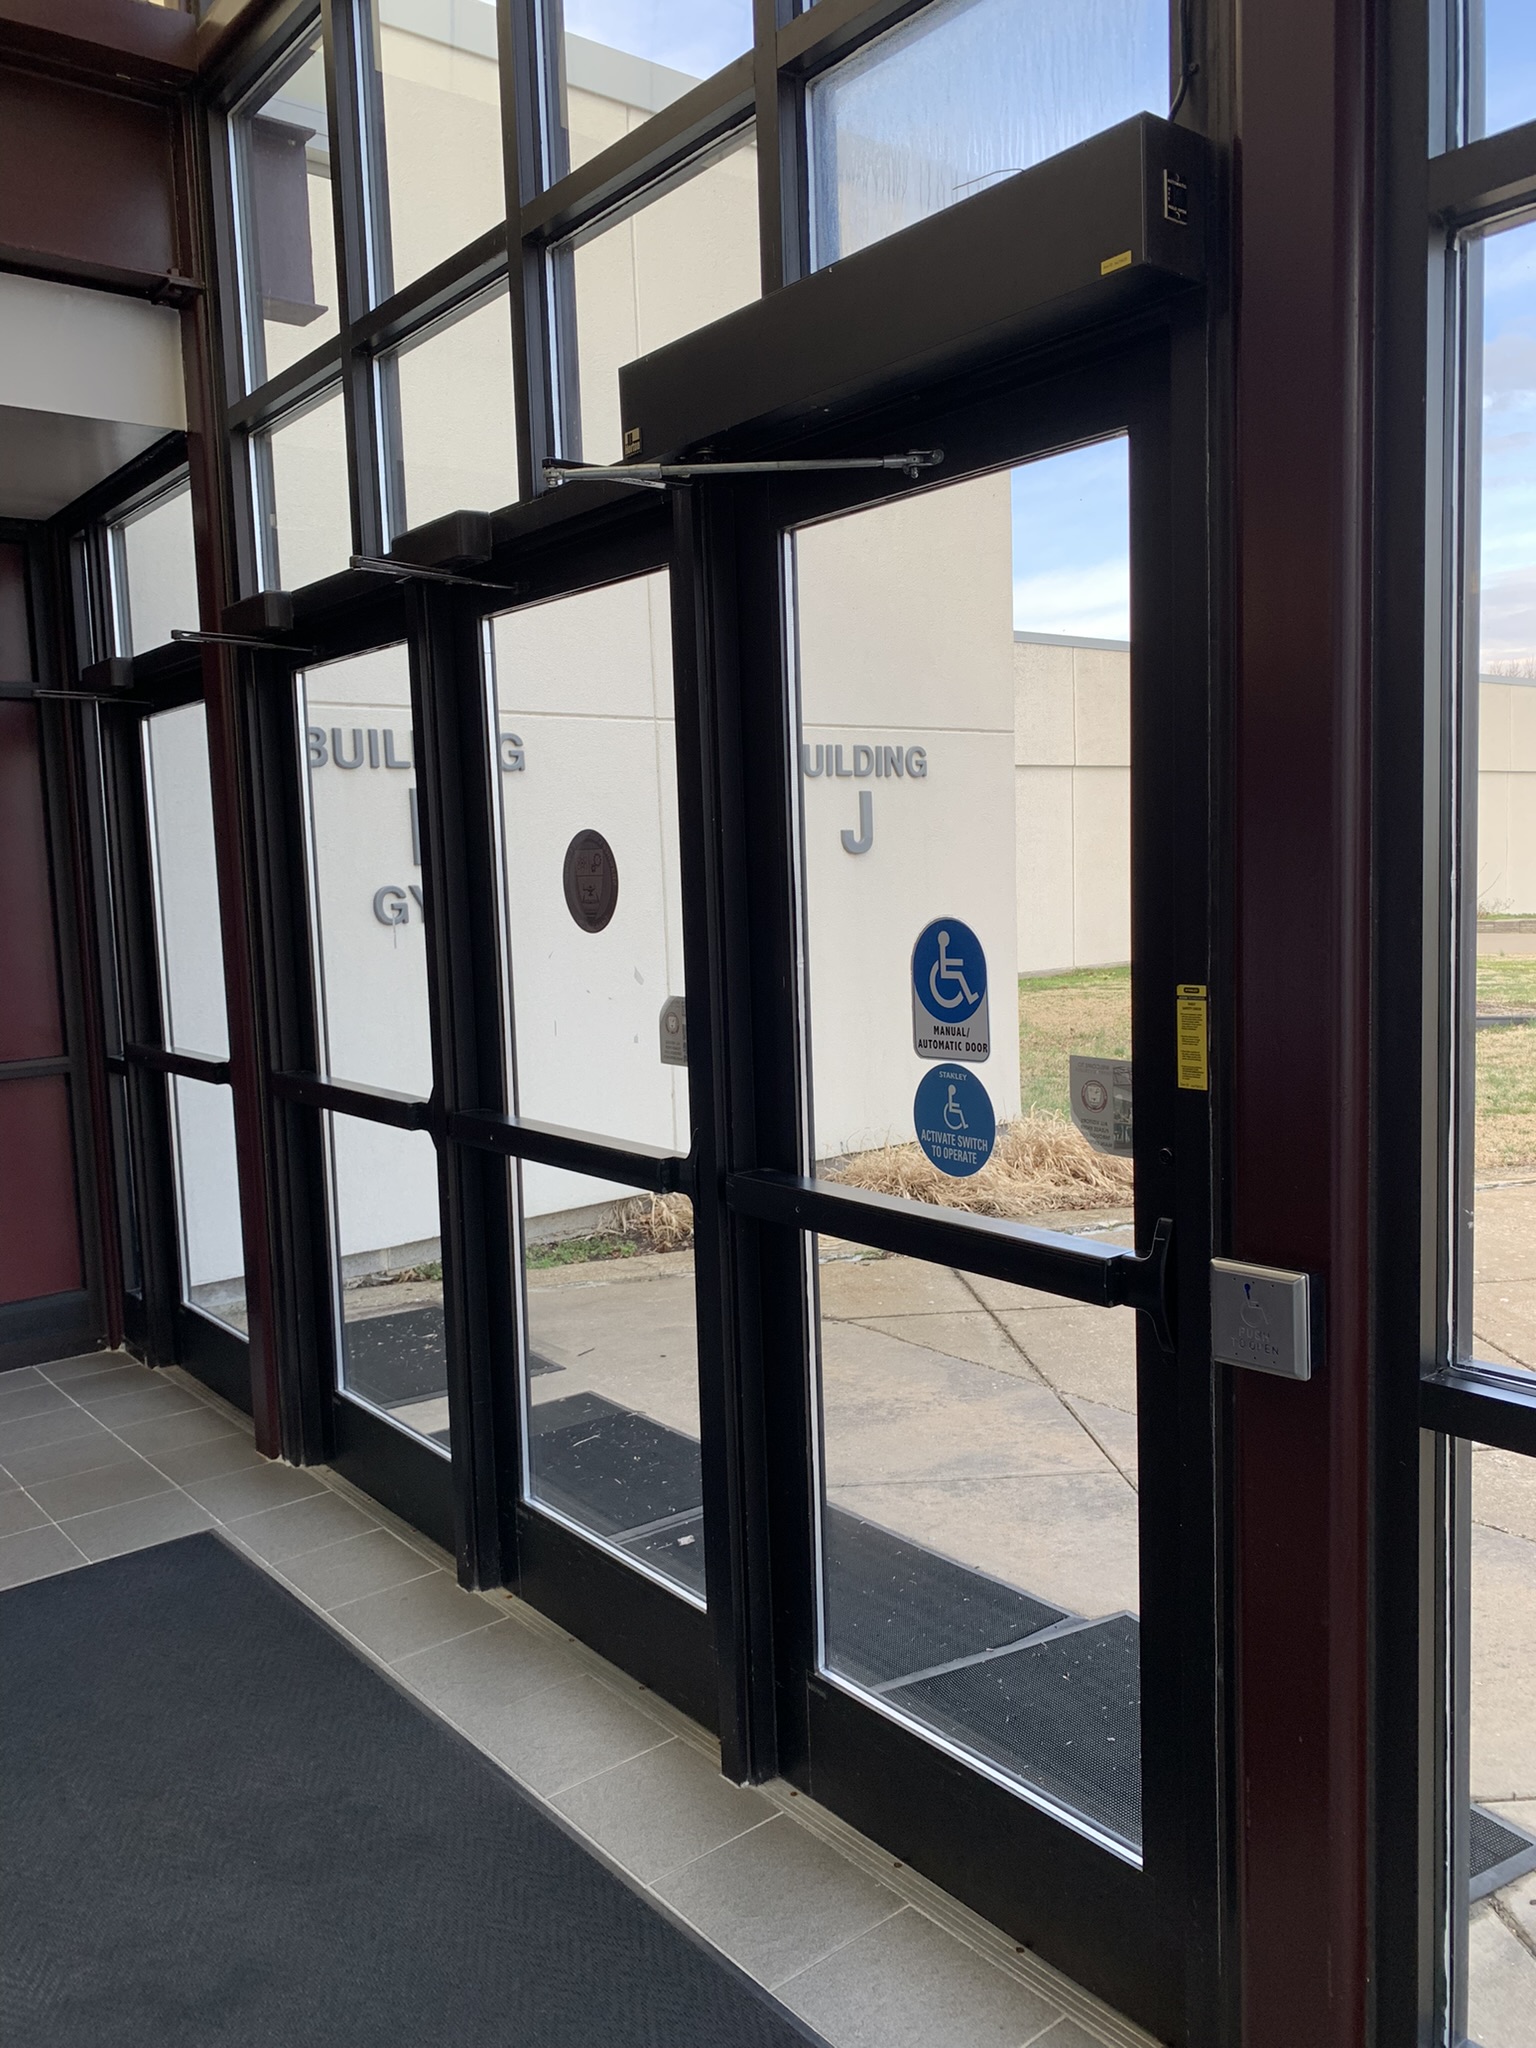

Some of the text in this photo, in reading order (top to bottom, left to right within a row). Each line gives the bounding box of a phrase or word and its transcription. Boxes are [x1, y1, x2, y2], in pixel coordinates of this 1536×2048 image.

[801, 744, 927, 778] UILDING
[840, 790, 873, 855] J
[373, 885, 424, 925] GY
[933, 1025, 970, 1038] MANUAL/
[918, 1039, 988, 1053] AUTOMATIC DOOR
[939, 1071, 967, 1081] STANLEY
[921, 1129, 988, 1152] ACTIVATE SWITCH
[931, 1145, 977, 1165] TO OPERATE
[1238, 1327, 1270, 1343] PUSH
[1231, 1336, 1279, 1355] TO OPEN
